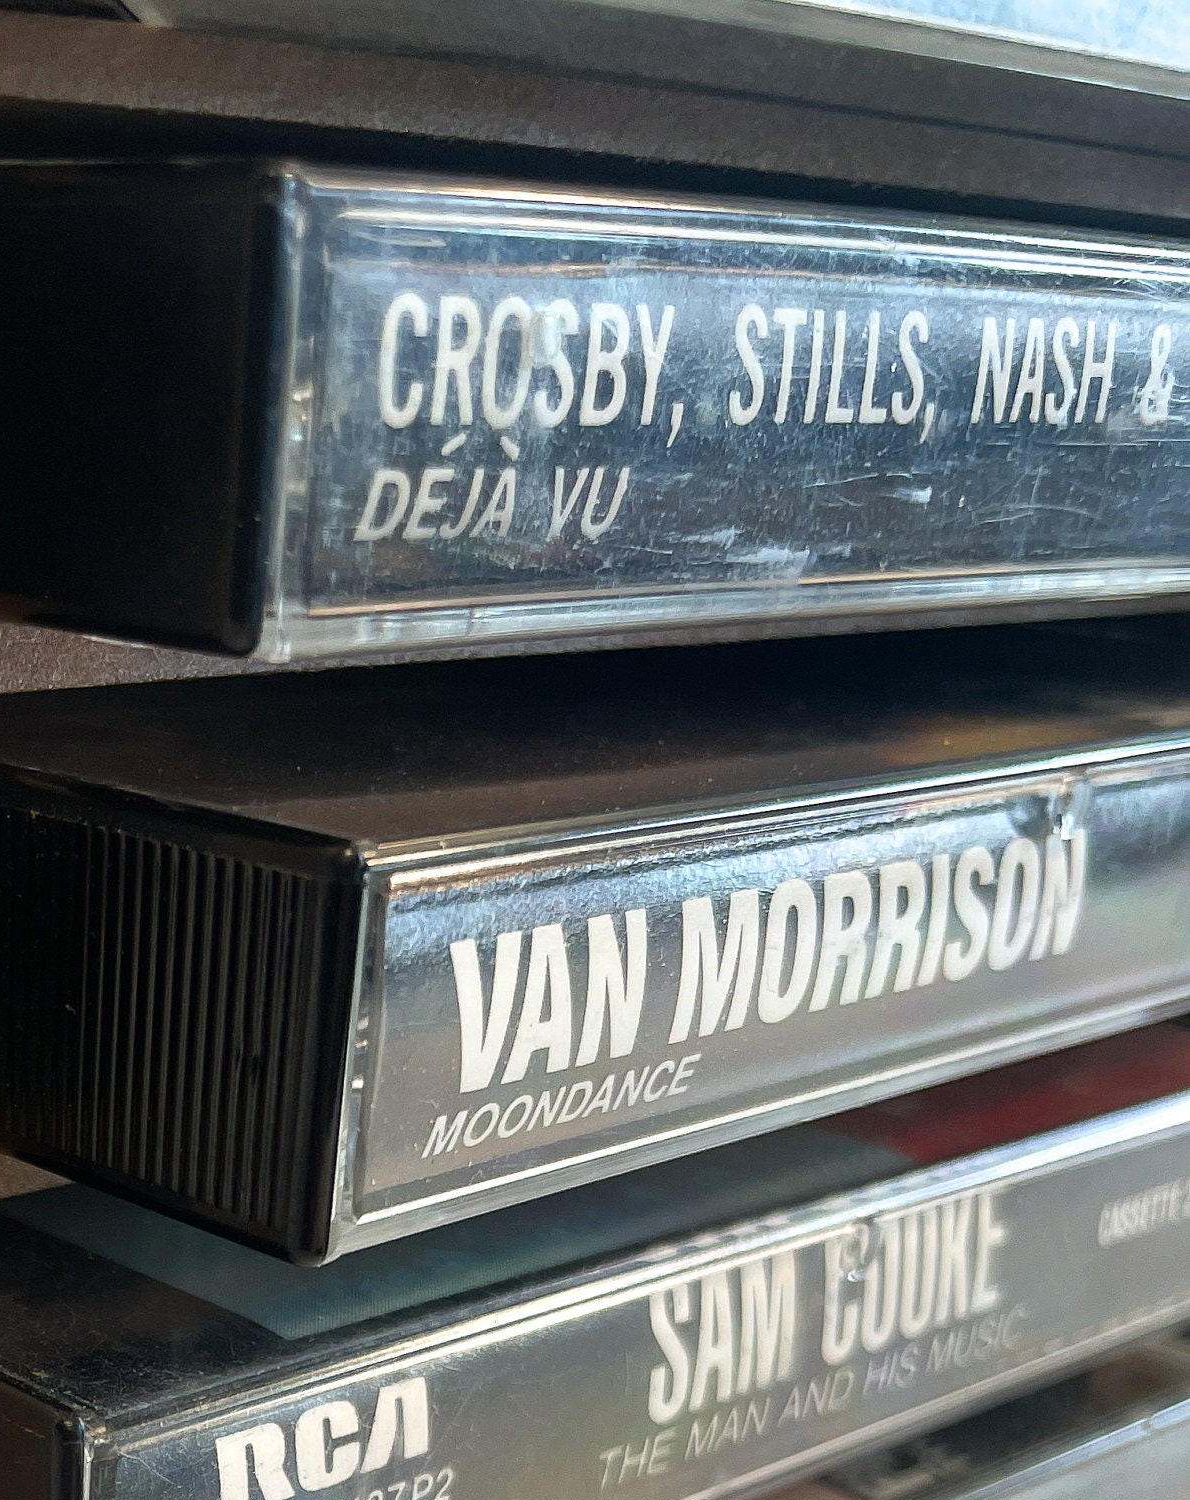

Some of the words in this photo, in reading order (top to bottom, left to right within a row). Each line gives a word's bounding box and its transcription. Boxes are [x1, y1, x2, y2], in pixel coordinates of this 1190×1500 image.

[378, 292, 685, 449] CROSBY,
[728, 303, 936, 444] STILLS,
[970, 316, 1117, 427] NASH
[1140, 324, 1175, 426] &
[354, 433, 520, 542] DÉJÀ
[546, 466, 630, 542] VU
[449, 908, 647, 1095] VAN
[667, 828, 1087, 1044] MORRISON
[421, 1053, 702, 1159] MOONDANCE
[597, 1427, 677, 1490] THE
[684, 1397, 772, 1462] MAN
[777, 1369, 855, 1428] AND
[863, 1341, 922, 1396] HIS
[925, 1301, 1029, 1375] MUSIC
[648, 1248, 800, 1426] SAM
[821, 1193, 1008, 1366] COOKE
